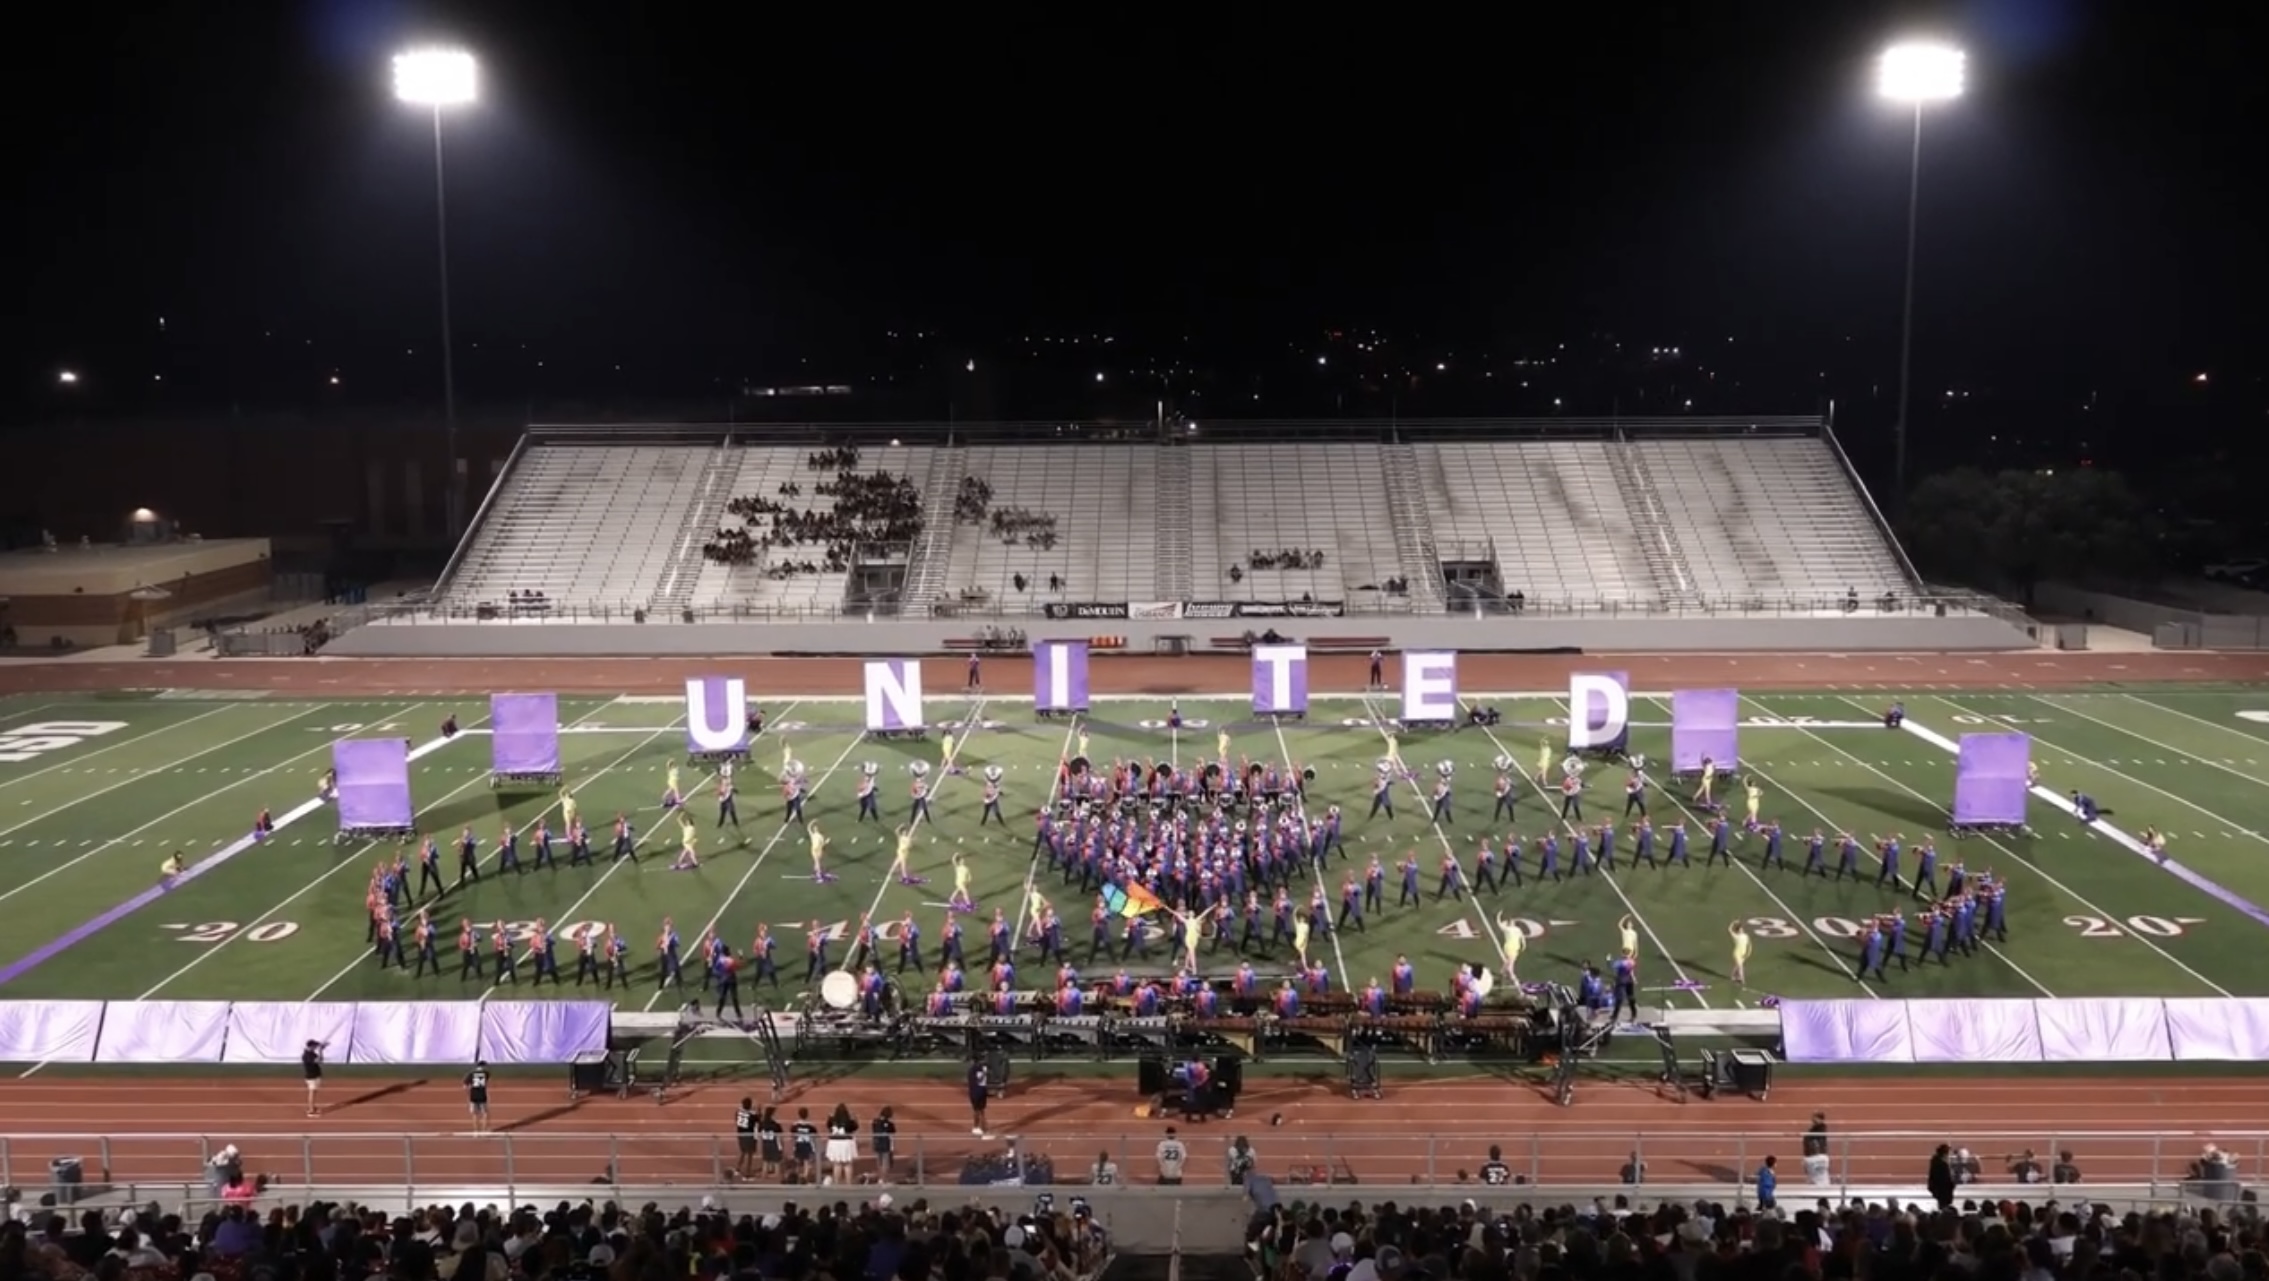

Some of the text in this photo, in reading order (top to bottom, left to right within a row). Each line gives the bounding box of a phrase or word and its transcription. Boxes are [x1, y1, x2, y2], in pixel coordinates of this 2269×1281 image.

[175, 921, 299, 942] 20
[1747, 916, 1862, 938] 30
[2062, 915, 2184, 936] 20
